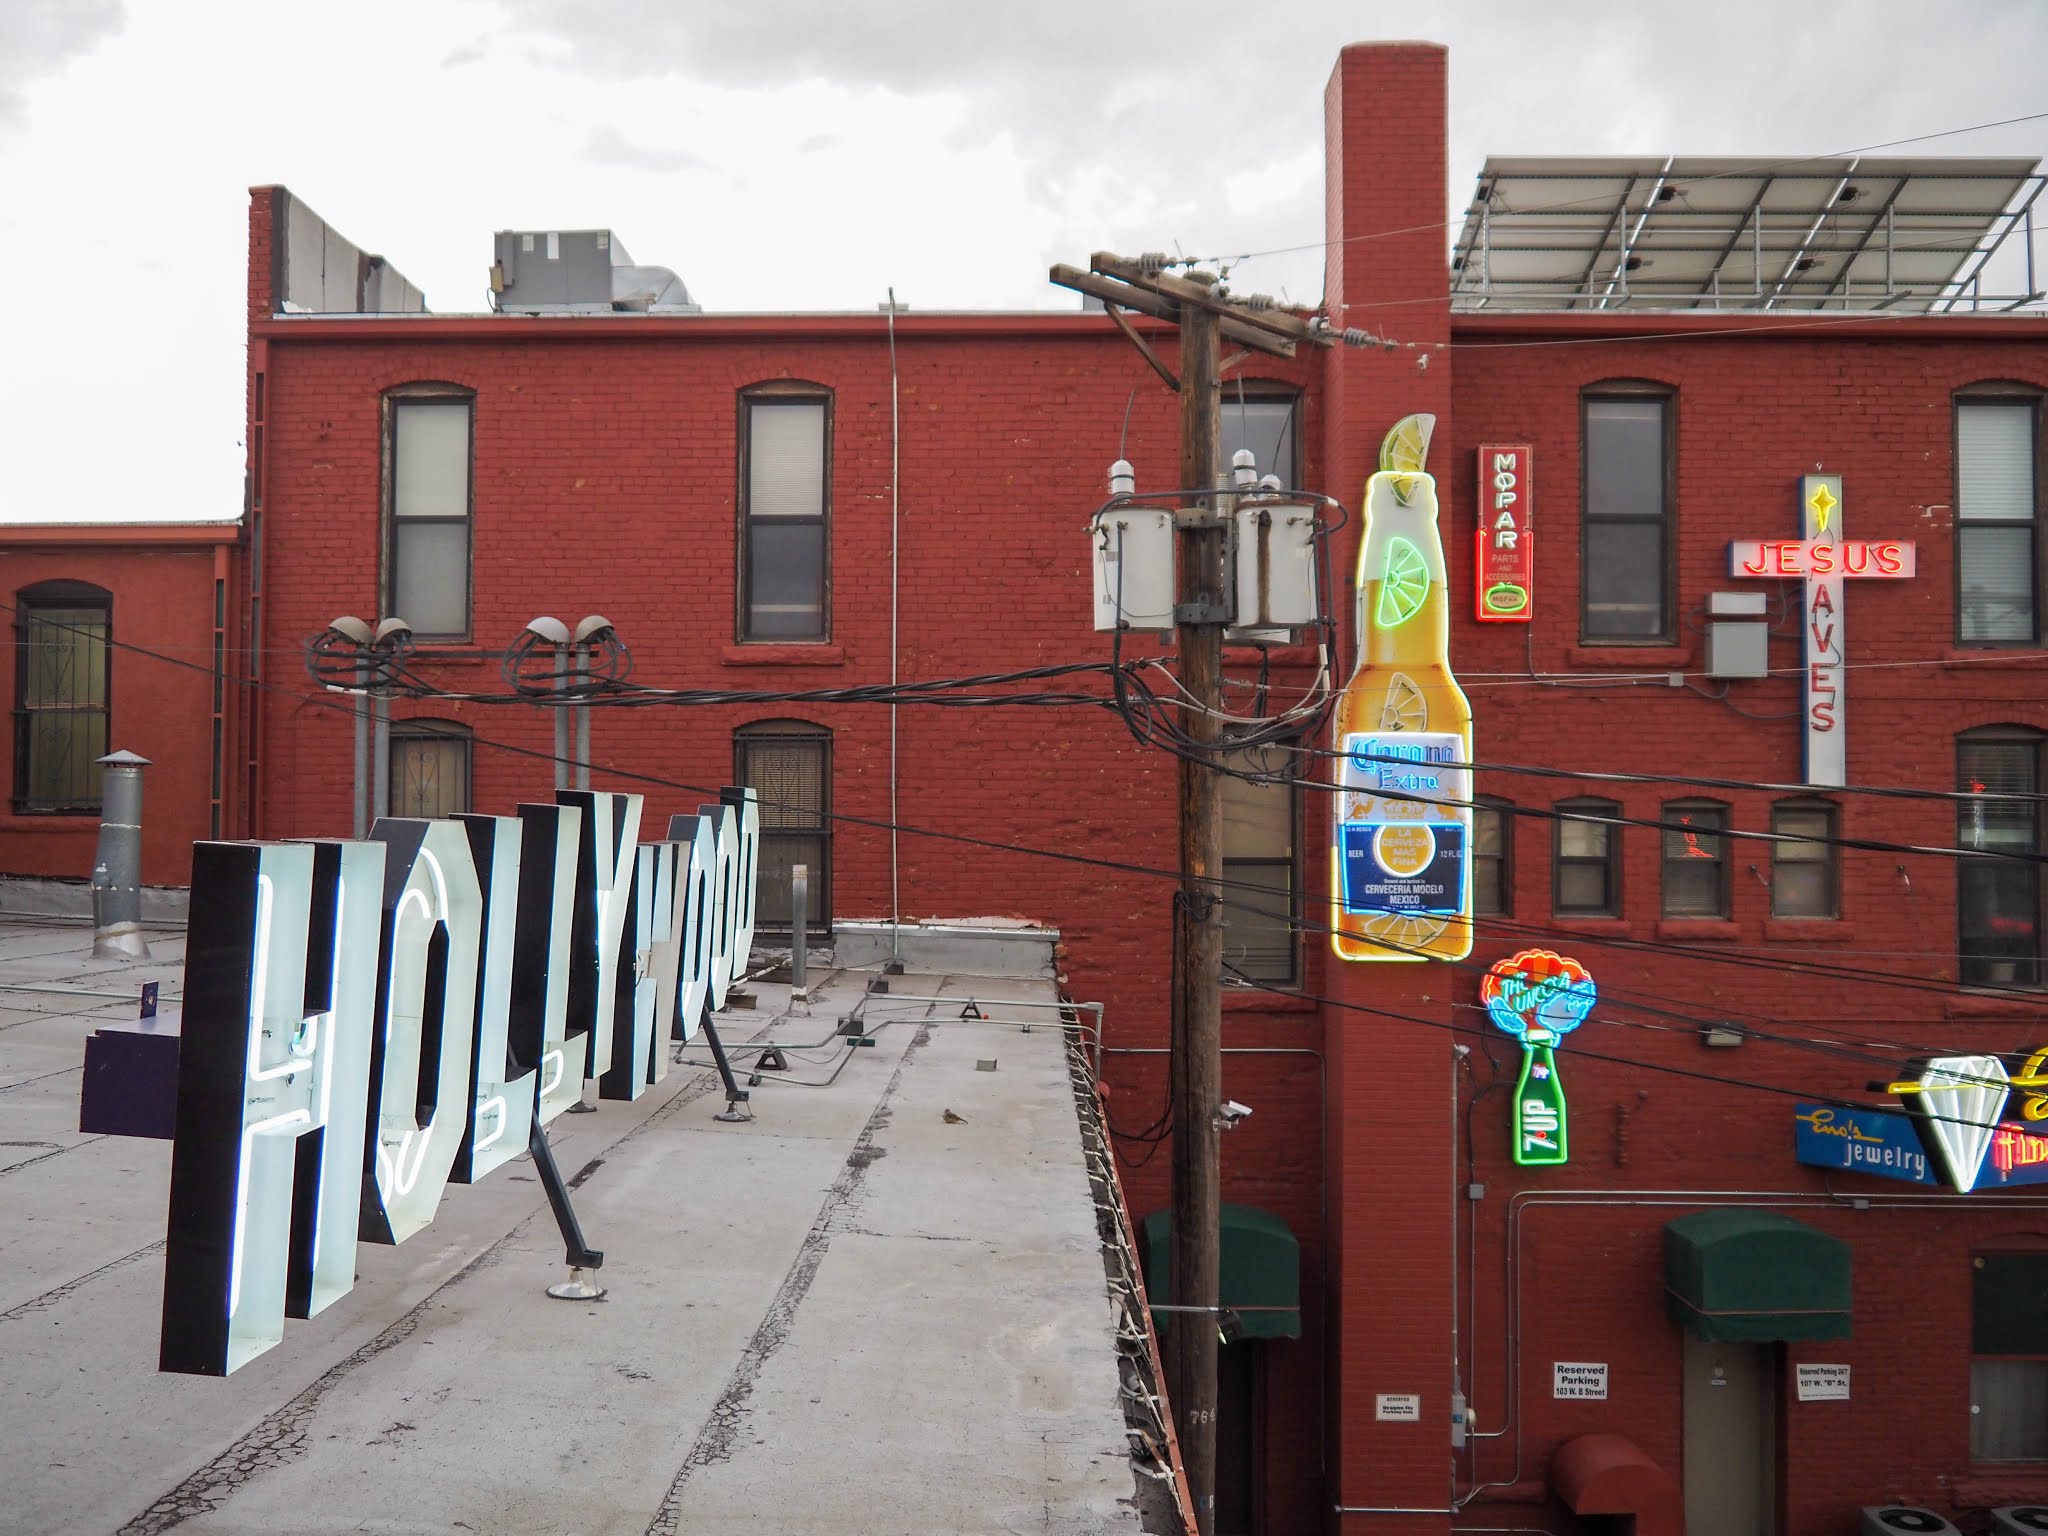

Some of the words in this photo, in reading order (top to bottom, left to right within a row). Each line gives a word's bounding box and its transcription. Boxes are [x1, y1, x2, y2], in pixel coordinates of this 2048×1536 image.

[1493, 453, 1517, 549] MOPAR
[1492, 554, 1519, 563] PARTS
[1743, 543, 1902, 574] JESUS
[1351, 738, 1455, 774] Corona
[1379, 768, 1439, 790] Extra
[1398, 829, 1411, 837] LA
[1381, 838, 1428, 847] CERVEZA
[1348, 850, 1364, 858] BEER
[1441, 850, 1448, 858] 12
[1393, 857, 1416, 865] FINA
[1365, 884, 1411, 894] CERVECERIA
[1413, 884, 1443, 894] MODELO
[1390, 895, 1420, 905] MEXICO
[160, 785, 757, 1377] HOLLYWOOD
[1523, 1100, 1558, 1151] 7UP
[1843, 1135, 1925, 1180] jewelry
[1557, 1365, 1605, 1375] Reserved
[1820, 1368, 1837, 1377] Parking
[1561, 1376, 1600, 1387] Parking
[1556, 1387, 1568, 1396] 103
[1578, 1387, 1584, 1396] B
[1585, 1387, 1605, 1396] Street
